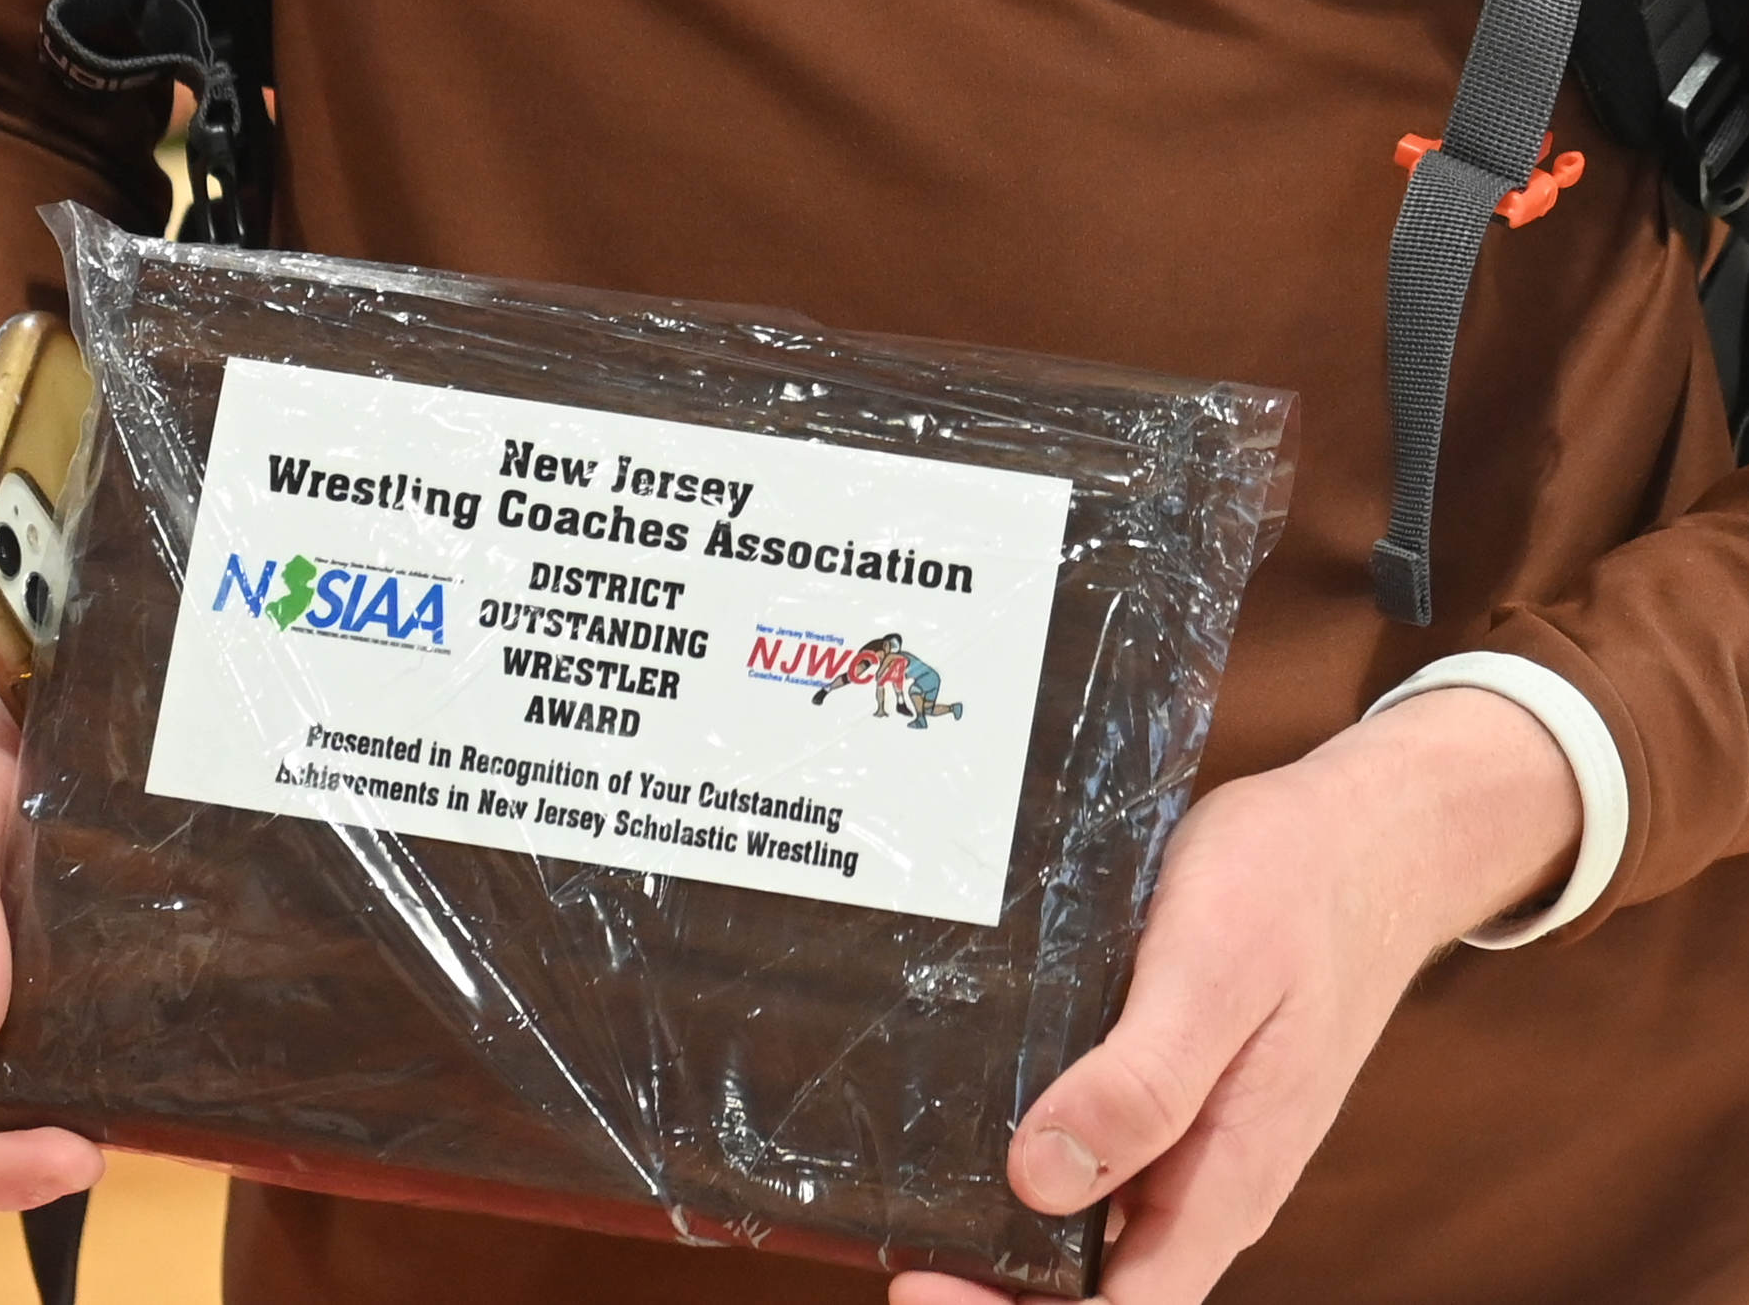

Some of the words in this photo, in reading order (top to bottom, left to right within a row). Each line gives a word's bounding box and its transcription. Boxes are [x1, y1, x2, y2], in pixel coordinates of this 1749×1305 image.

[499, 439, 599, 488] New
[610, 455, 754, 518] Jersey
[268, 454, 482, 530] Wrestling
[497, 489, 690, 552] Coaches
[703, 519, 973, 593] Association
[528, 561, 685, 610] DISTRICT
[478, 598, 709, 659] OUTSTANDING
[503, 646, 681, 700] WRESTLER
[747, 636, 909, 692] NJWCA
[524, 695, 641, 738] AWARD
[305, 722, 423, 764] Presented
[428, 741, 453, 769] in
[459, 744, 600, 791] Recognition
[607, 770, 633, 795] of
[639, 772, 692, 806] Your
[698, 781, 844, 834] Outstanding
[446, 784, 470, 812] in
[477, 787, 529, 820] New
[534, 797, 607, 839] Jersey
[613, 809, 739, 853] Scholastic
[746, 830, 860, 878] Wrestling
